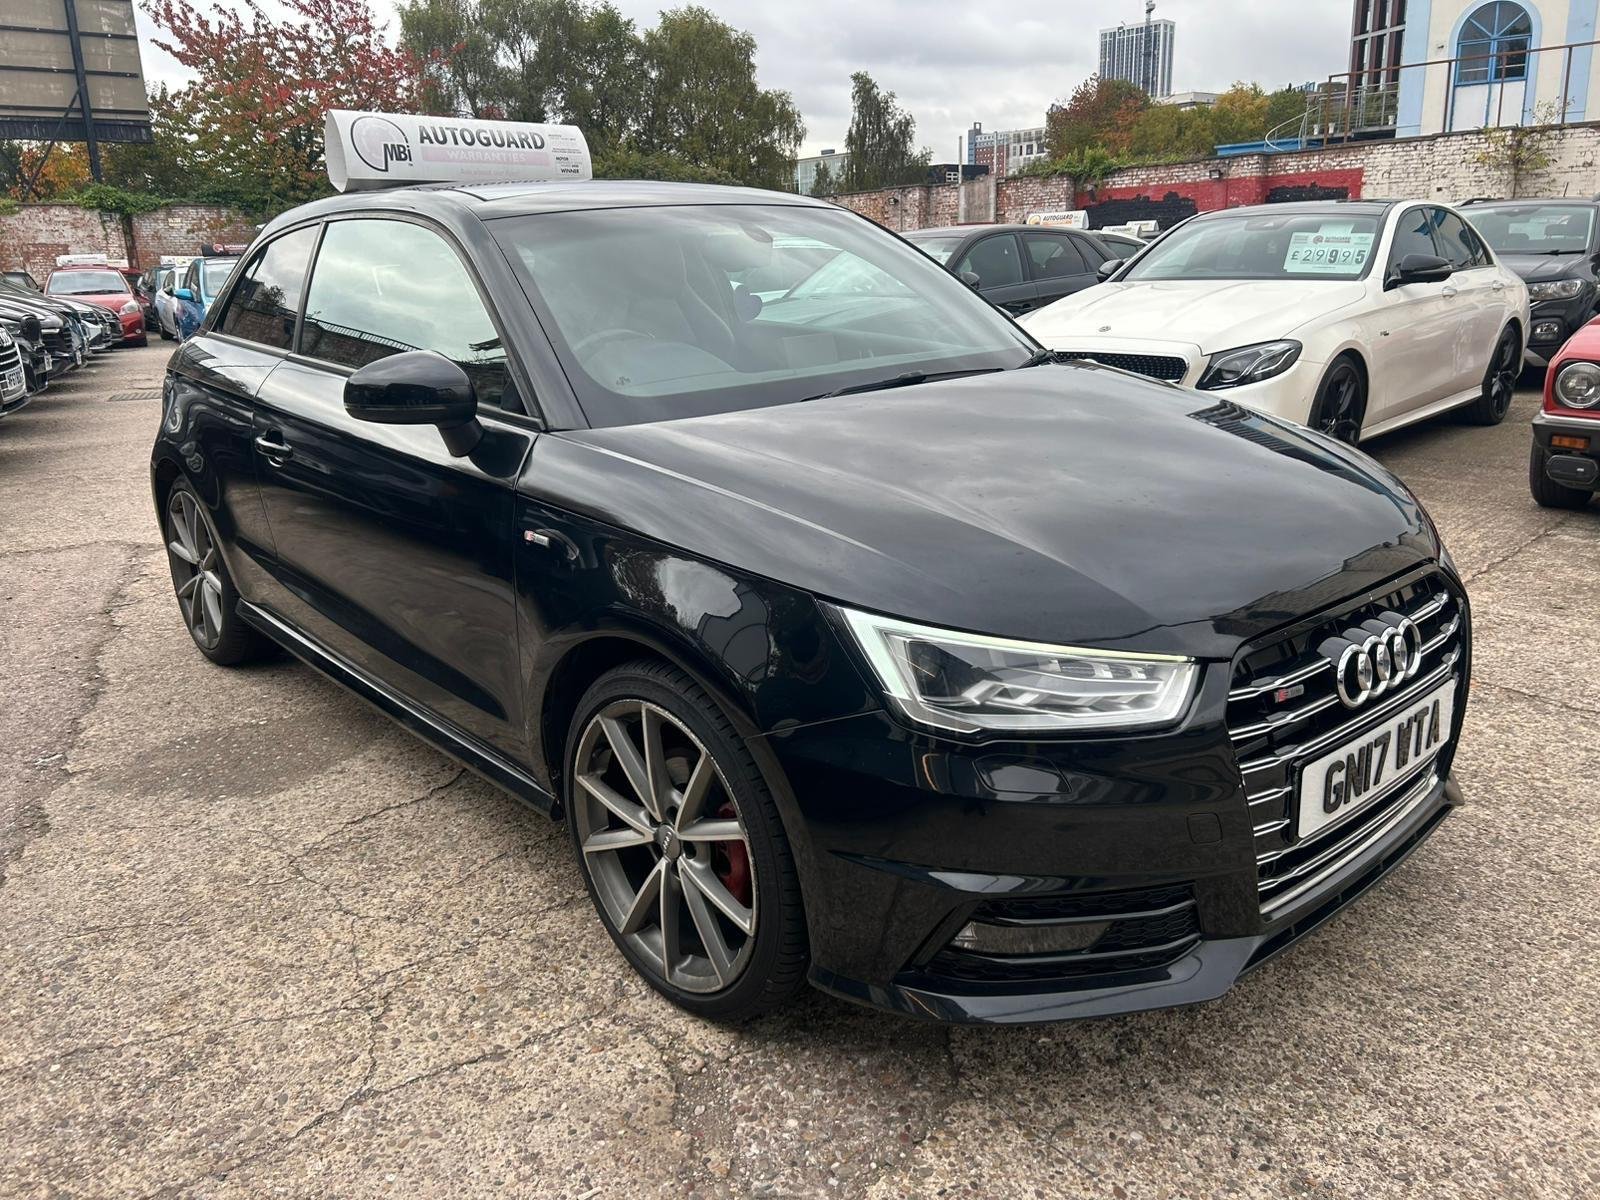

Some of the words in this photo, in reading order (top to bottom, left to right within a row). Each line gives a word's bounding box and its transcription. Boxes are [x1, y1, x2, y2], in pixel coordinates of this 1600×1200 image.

[418, 125, 546, 149] AUTOGUARD
[383, 143, 412, 162] MBi
[447, 149, 527, 163] WARRANTIES
[1042, 213, 1074, 221] AUTOGUARD
[1322, 730, 1392, 814] GN17
